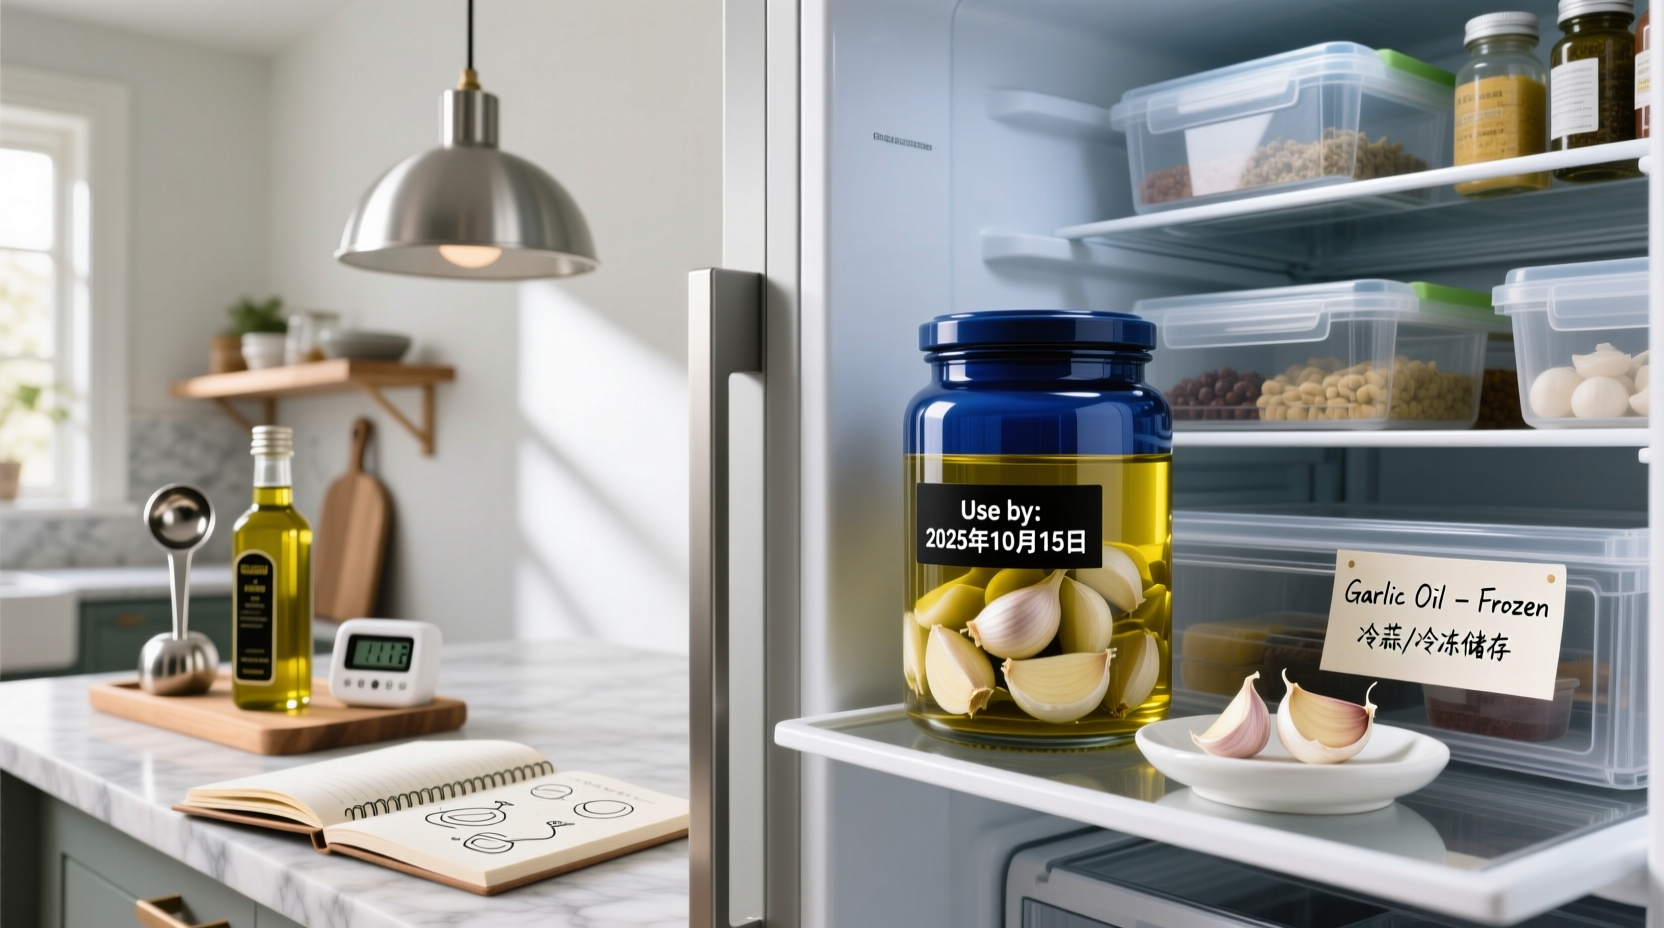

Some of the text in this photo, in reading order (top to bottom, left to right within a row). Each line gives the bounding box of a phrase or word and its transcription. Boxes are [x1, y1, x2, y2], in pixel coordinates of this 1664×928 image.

[961, 499, 1041, 527] Use by:
[925, 527, 1086, 554] 2025年10月15日
[1345, 579, 1406, 605] Garlic
[1415, 583, 1446, 609] Oil
[1478, 587, 1549, 618] Frozen
